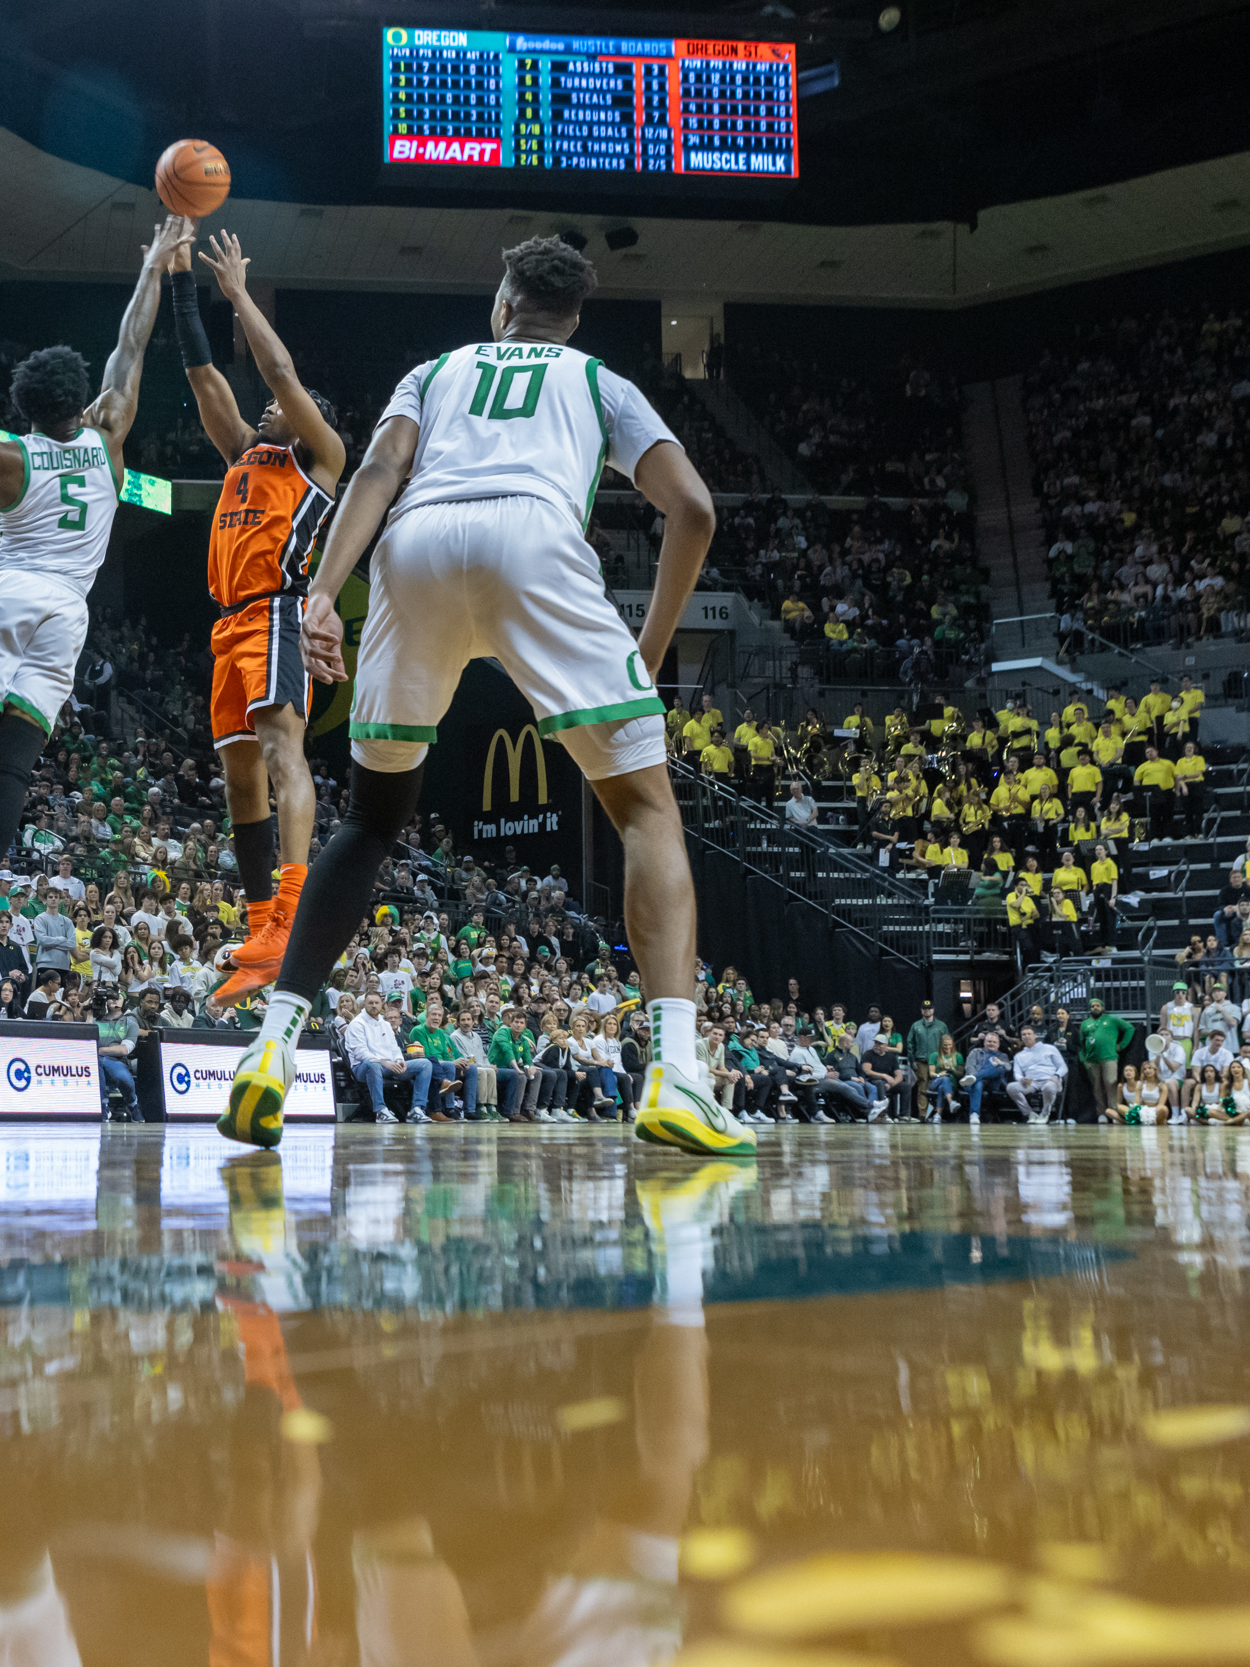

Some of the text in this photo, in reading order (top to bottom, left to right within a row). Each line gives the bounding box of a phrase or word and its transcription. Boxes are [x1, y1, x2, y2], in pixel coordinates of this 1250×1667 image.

[415, 30, 468, 47] OREGON
[572, 39, 616, 54] HUSTLE
[621, 40, 666, 56] BOARDS
[687, 42, 738, 57] OREGON
[423, 62, 429, 73] 7
[568, 61, 614, 74] ASSISTS
[560, 76, 623, 91] TURNOVERS
[571, 92, 612, 106] STEALS
[563, 108, 620, 122] REBOUNDS
[557, 124, 588, 135] FIELD
[592, 125, 627, 138] GOALS
[556, 140, 583, 153] FREE
[588, 141, 629, 154] THROWS
[560, 156, 625, 170] 3-POINTERS
[690, 150, 785, 172] MUSCLE MILK
[475, 344, 564, 361] EVANS
[468, 361, 549, 420] 10
[31, 447, 107, 471] COUISNARD
[236, 472, 250, 503] 4
[57, 474, 87, 531] 5
[219, 509, 266, 530] STATE
[701, 606, 729, 620] 116
[473, 812, 559, 840] i'm lovin' it
[35, 1064, 91, 1077] CUMULUS
[193, 1069, 236, 1081] CUMULU
[36, 1079, 91, 1087] MEDIA
[295, 1072, 326, 1084] MULUS
